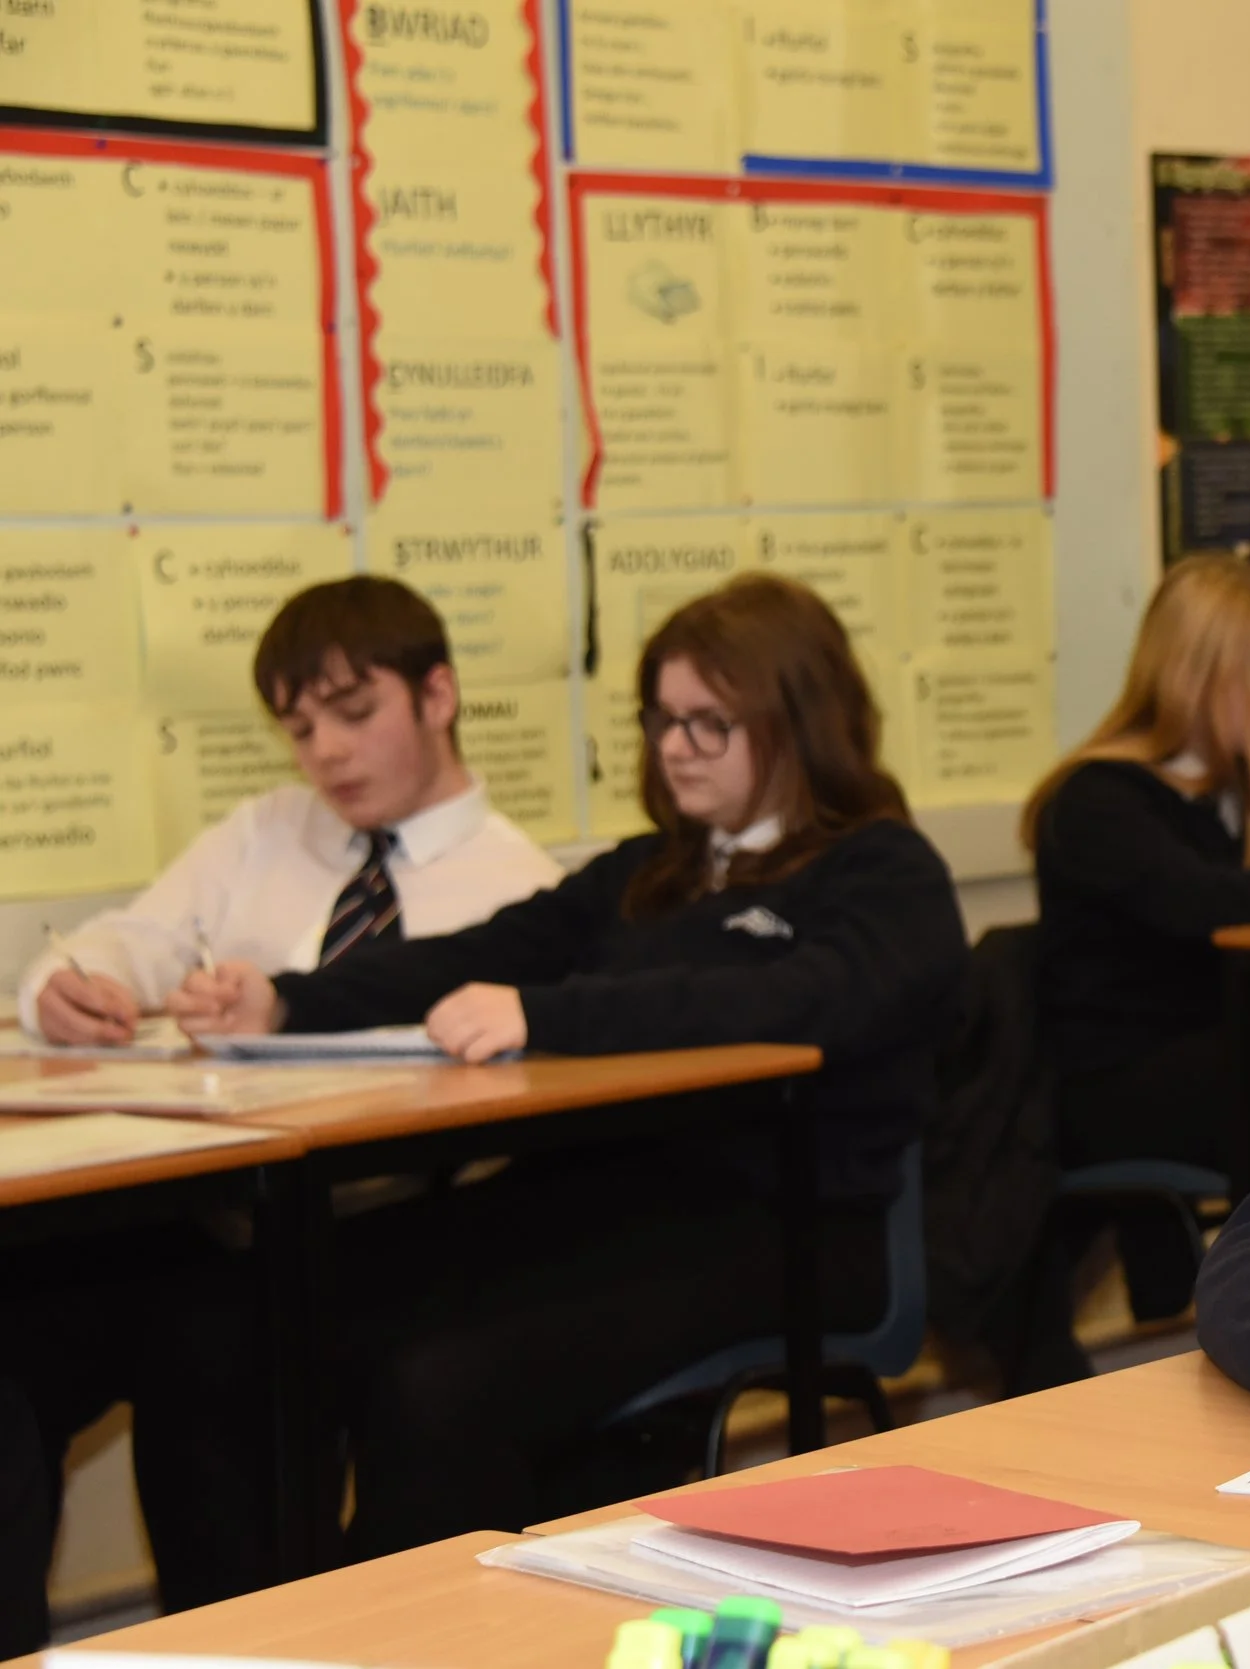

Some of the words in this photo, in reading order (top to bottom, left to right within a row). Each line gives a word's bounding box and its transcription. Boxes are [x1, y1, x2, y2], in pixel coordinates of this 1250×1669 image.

[367, 4, 490, 47] BWRIAD
[133, 336, 156, 374] S
[153, 549, 178, 585] C
[393, 535, 544, 567] STRWYTHUR
[156, 716, 178, 756] S
